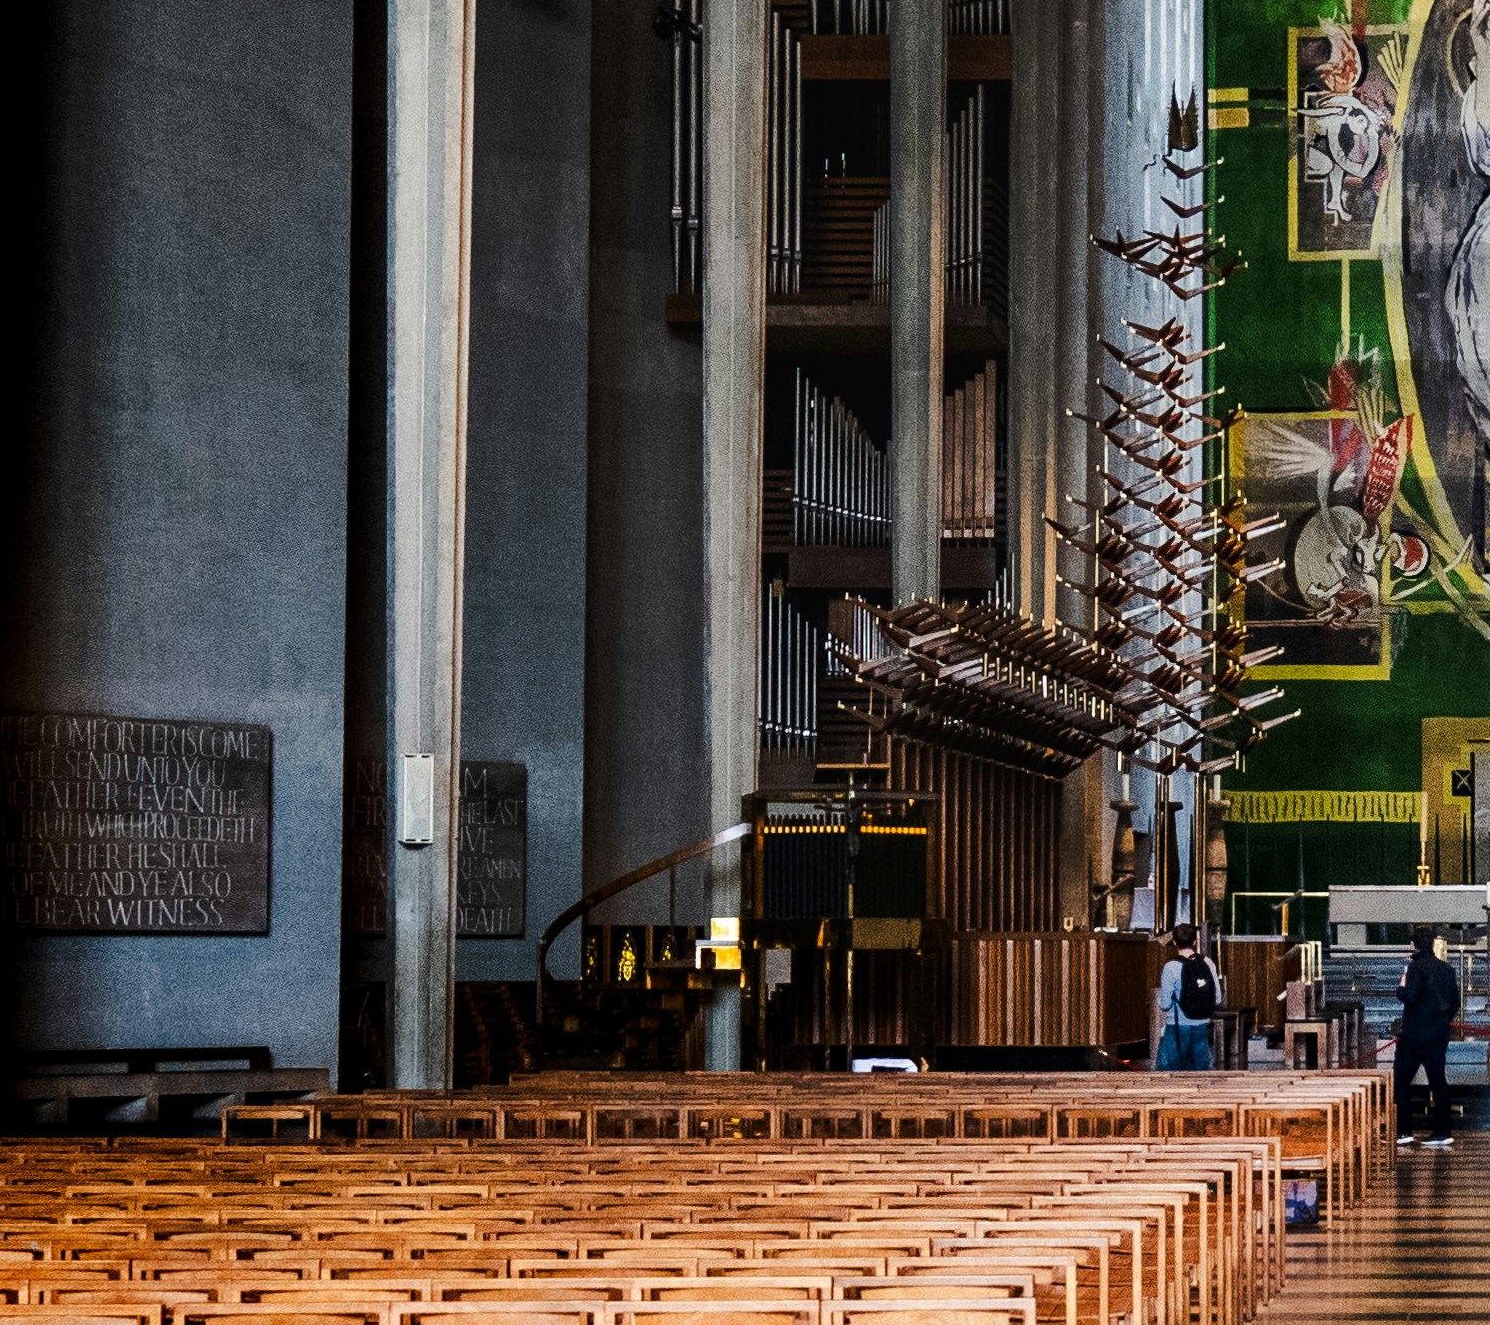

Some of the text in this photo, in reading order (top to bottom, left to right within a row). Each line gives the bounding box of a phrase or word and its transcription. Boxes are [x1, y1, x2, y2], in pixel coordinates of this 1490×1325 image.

[40, 715, 177, 756] COMFORTER
[180, 724, 198, 756] IS
[198, 726, 260, 761] COME
[64, 750, 122, 782] SEND
[123, 753, 180, 785] UNTO
[181, 756, 227, 789] YOU
[29, 779, 121, 811] FATHER
[138, 784, 206, 814] EVEN
[208, 787, 246, 816] THE
[84, 811, 143, 839] WHICH
[143, 811, 255, 844] PROCEEDETH
[27, 842, 122, 870] FATHER
[128, 842, 158, 870] HE
[159, 841, 228, 870] SHALL
[85, 870, 136, 897] AND
[137, 870, 169, 897] YE
[170, 870, 233, 898] ALSO
[35, 897, 101, 926] BEAR
[107, 897, 226, 927] WITNESS
